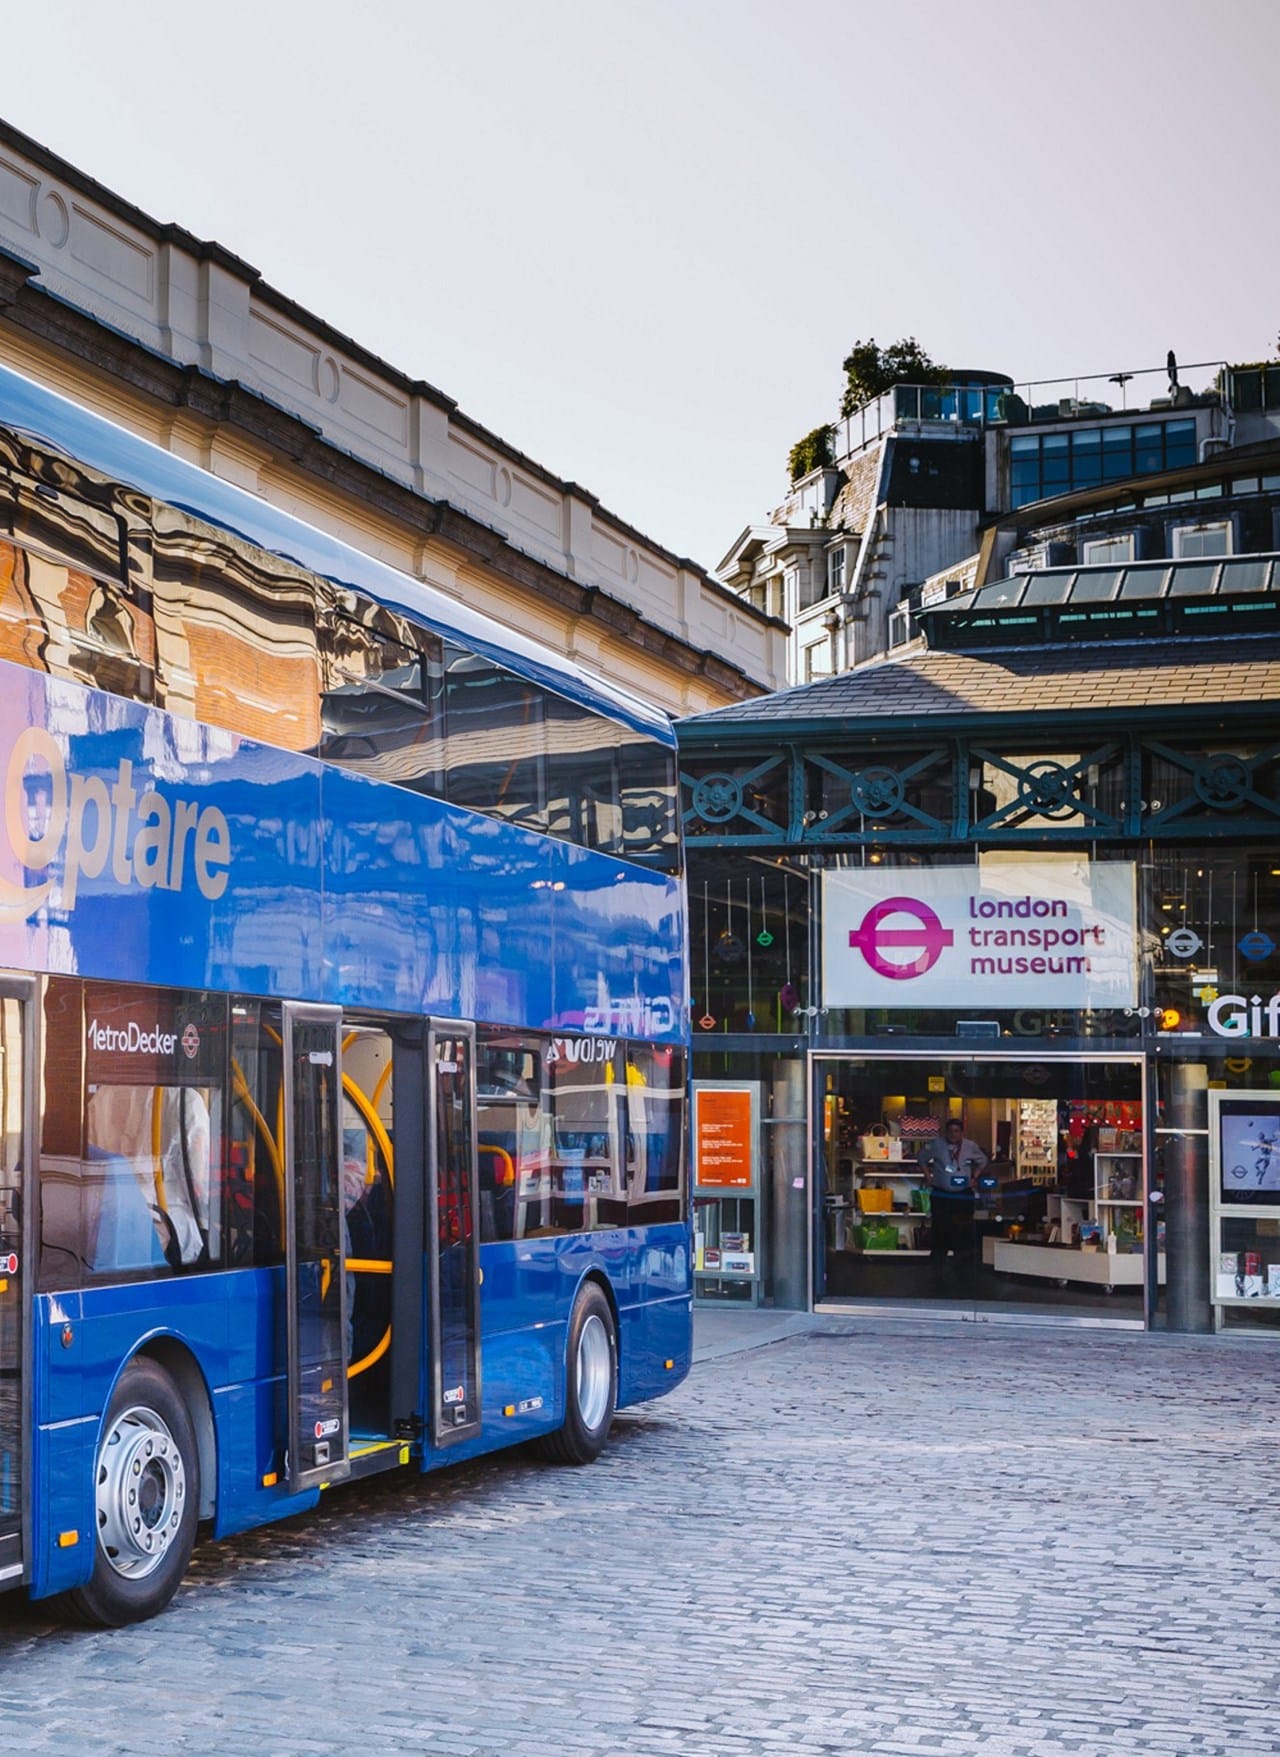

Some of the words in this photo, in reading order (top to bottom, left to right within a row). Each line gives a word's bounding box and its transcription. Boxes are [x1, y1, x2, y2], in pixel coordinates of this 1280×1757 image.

[5, 726, 231, 911] Optare
[969, 896, 1068, 919] london
[968, 925, 1105, 951] transport
[970, 956, 1092, 975] museum
